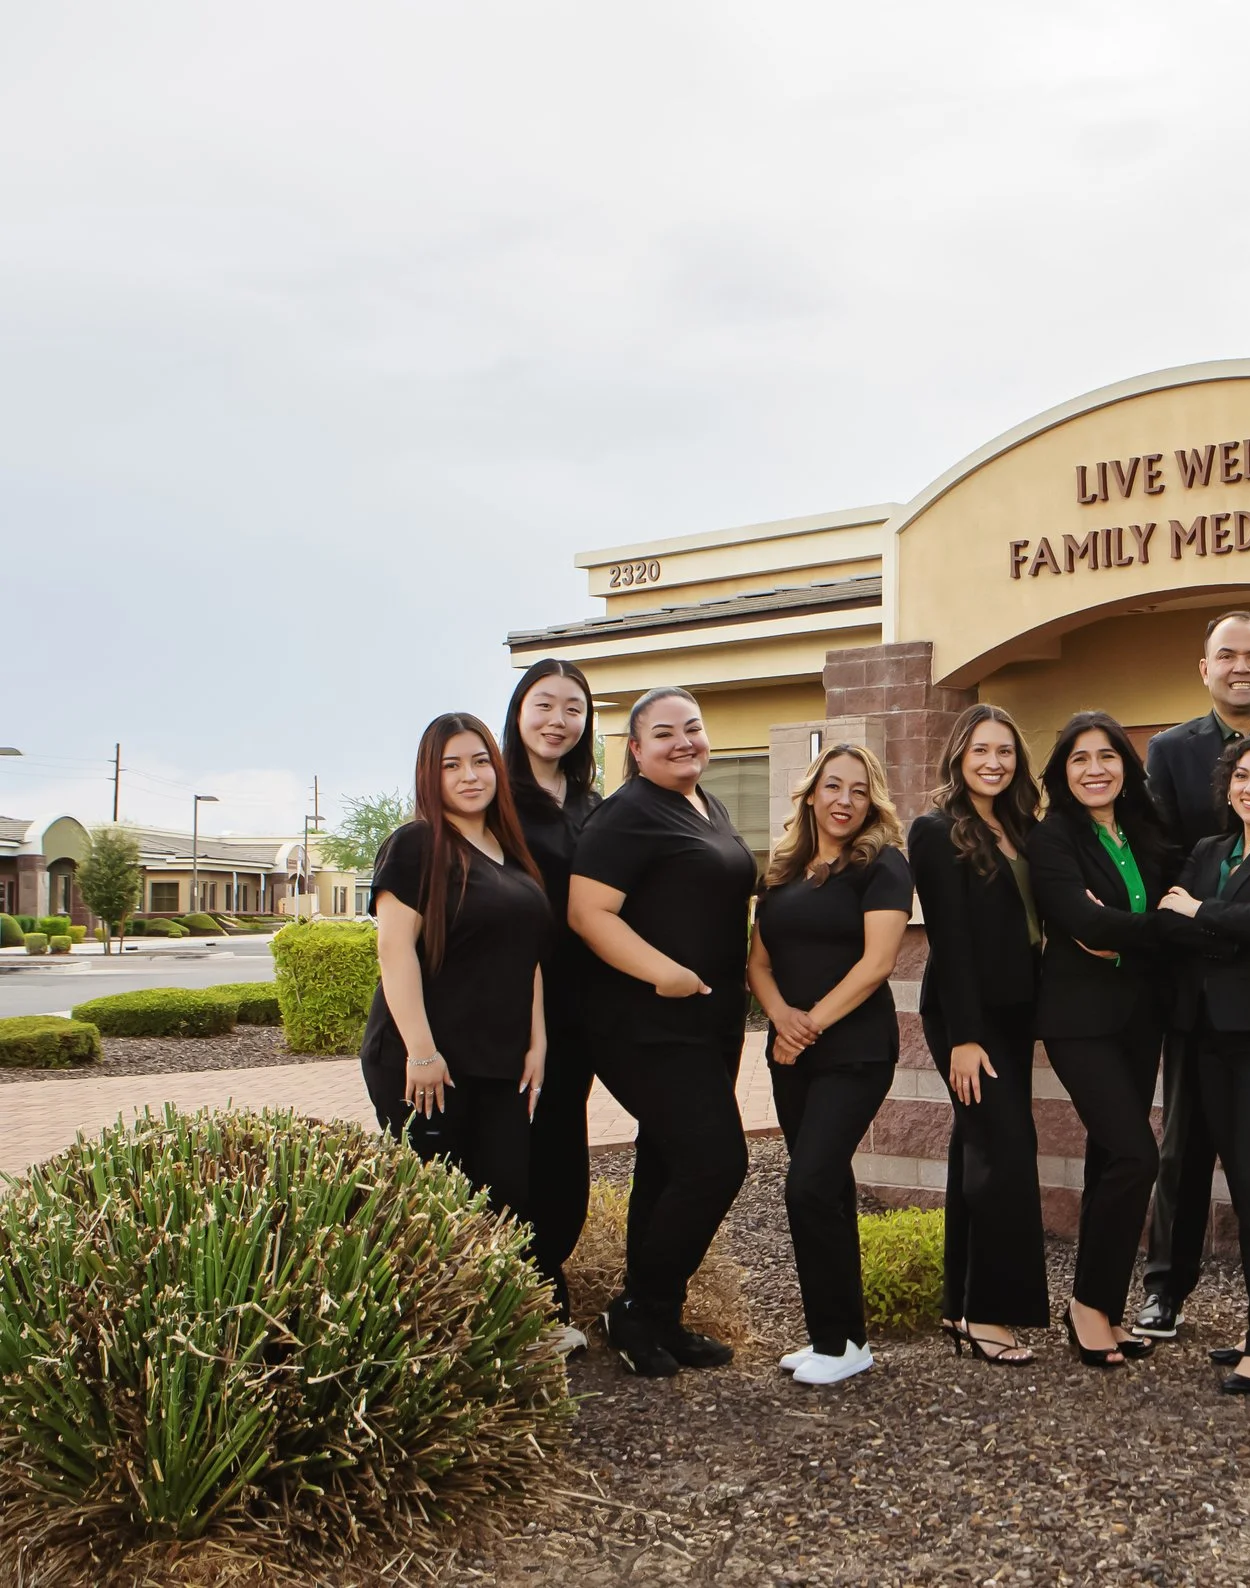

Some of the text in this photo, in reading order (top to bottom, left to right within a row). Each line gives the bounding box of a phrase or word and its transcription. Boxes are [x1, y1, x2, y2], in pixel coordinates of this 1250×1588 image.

[1076, 454, 1165, 504] LIVE
[609, 560, 661, 588] 2320
[1010, 523, 1157, 579] FAMILY
